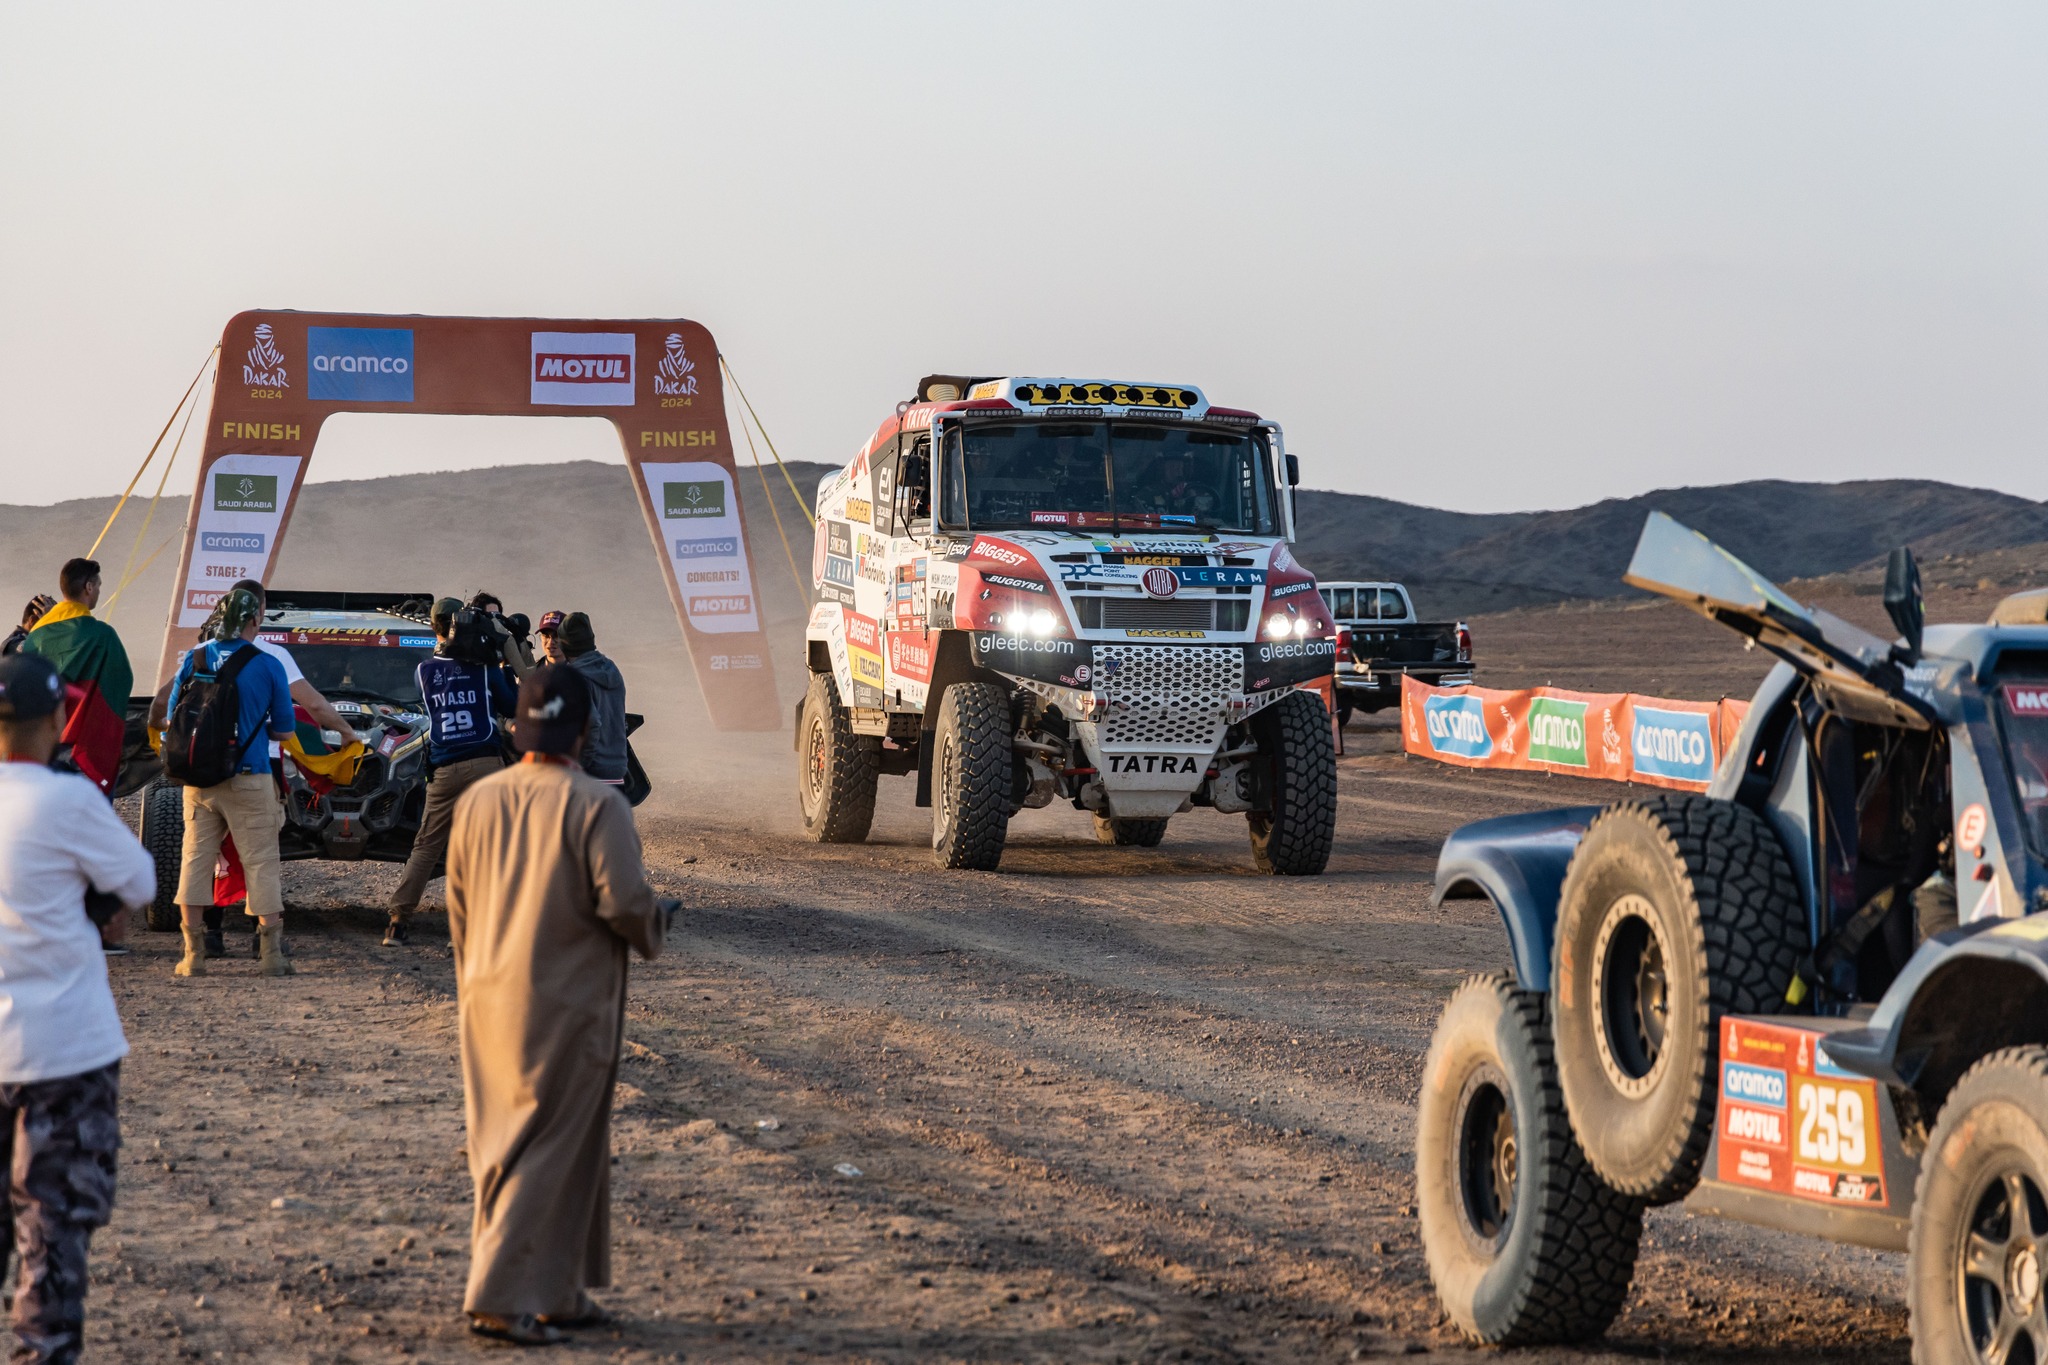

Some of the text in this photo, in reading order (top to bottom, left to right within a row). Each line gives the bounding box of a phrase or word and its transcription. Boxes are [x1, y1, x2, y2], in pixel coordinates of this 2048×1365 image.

[313, 355, 408, 374] aramco
[540, 358, 625, 378] MOTUL
[243, 365, 289, 388] DAKAR
[654, 375, 699, 395] DAKAR
[251, 389, 282, 399] 2024
[661, 398, 692, 408] 2024
[907, 408, 937, 429] TATRA
[223, 422, 300, 440] FINISH
[641, 430, 716, 447] FINISH
[217, 500, 272, 509] SAUDI ARABIA
[206, 536, 260, 548] aramco
[681, 541, 732, 554] aramco
[974, 541, 1027, 566] BIGGEST
[206, 566, 246, 578] STAGE 2
[687, 570, 739, 583] CONGRATS!
[1182, 571, 1262, 583] LERAM
[988, 575, 1044, 592] BUGGYRA
[1147, 570, 1173, 595] TATRA
[1274, 582, 1311, 597] BUGGYRA
[693, 598, 747, 612] MOTUL
[256, 634, 285, 642] OTUL
[979, 634, 1074, 654] gleec.com
[1260, 641, 1336, 662] gleec.com
[1079, 669, 1087, 679] E
[432, 690, 477, 707] TV A.S.O
[441, 710, 473, 733] 29
[1637, 724, 1705, 766] aramco
[1108, 756, 1198, 773] TATRA
[1964, 815, 1979, 841] E
[1727, 1068, 1783, 1101] aramco
[1728, 1107, 1782, 1143] MOTUL
[1799, 1083, 1866, 1165] 259
[1795, 1170, 1831, 1194] MOTUL
